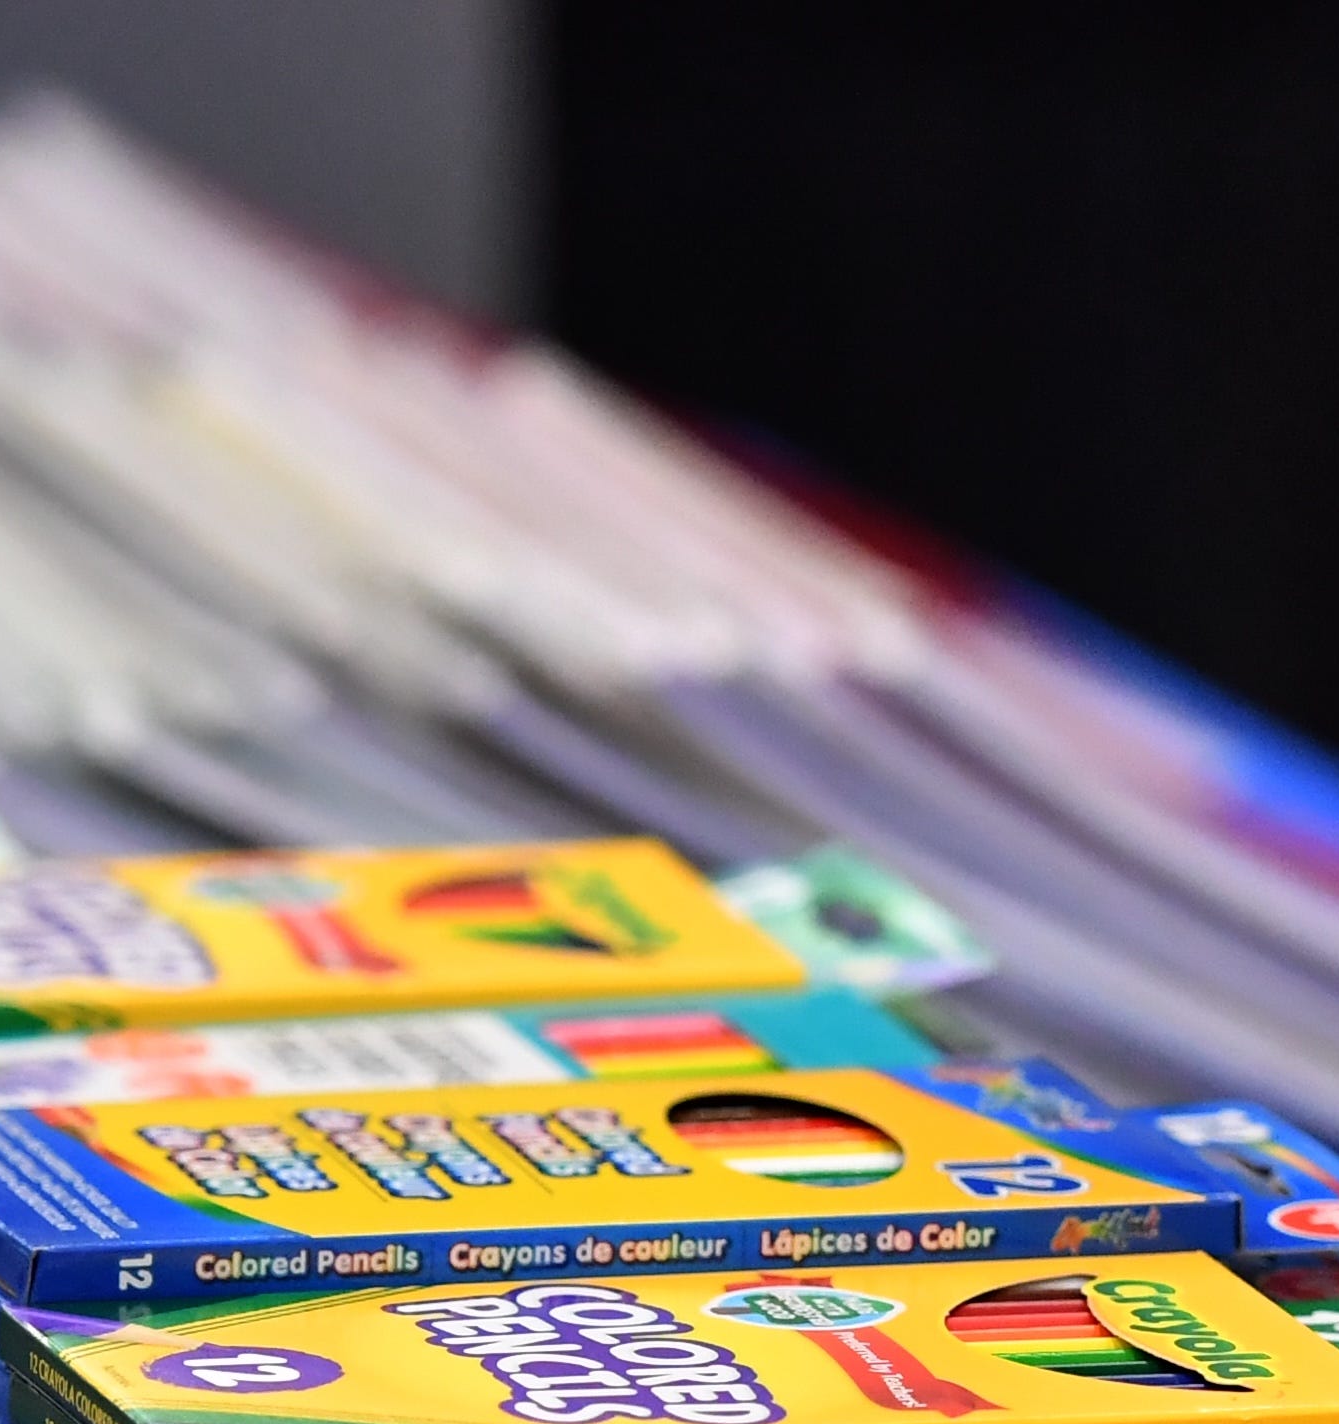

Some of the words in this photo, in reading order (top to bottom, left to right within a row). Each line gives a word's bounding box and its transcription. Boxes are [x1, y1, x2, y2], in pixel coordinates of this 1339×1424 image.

[937, 1152, 1089, 1199] 12
[449, 1242, 567, 1273] Crayons
[576, 1235, 613, 1264] de
[619, 1233, 728, 1264] couleur
[761, 1226, 868, 1262] Lápices
[876, 1224, 914, 1253] de
[919, 1221, 996, 1251] Color
[119, 1253, 153, 1291] 12
[195, 1250, 308, 1281] Colored
[317, 1244, 420, 1275] Pencils
[832, 1331, 889, 1364] Preferred
[1092, 1279, 1275, 1380] Crayola
[28, 1350, 38, 1374] 12
[37, 1357, 75, 1405] CRAYOLA
[182, 1353, 302, 1388] 12
[395, 1297, 654, 1423] PENCILS
